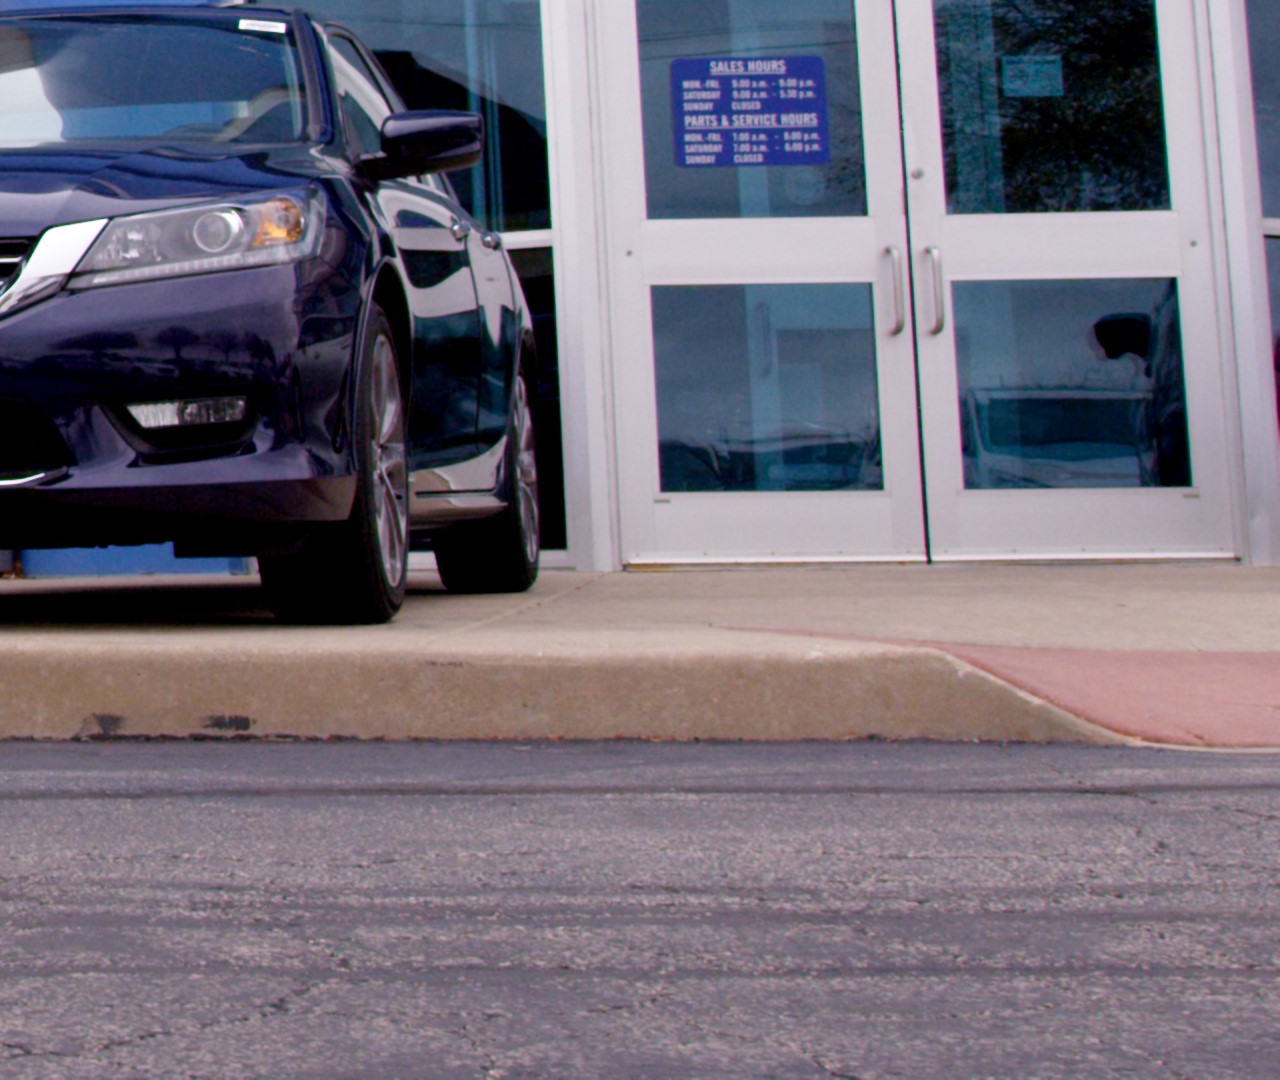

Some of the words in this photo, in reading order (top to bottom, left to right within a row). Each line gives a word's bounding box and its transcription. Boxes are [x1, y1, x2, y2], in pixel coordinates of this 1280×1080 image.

[709, 60, 745, 73] SALES
[747, 60, 787, 72] HOURS
[683, 101, 715, 112] SUNDAY
[731, 100, 762, 111] CLOSED
[684, 114, 719, 127] PARTS
[721, 114, 730, 127] &
[731, 113, 777, 127] SERVICE
[780, 112, 818, 126] HOURS
[685, 154, 717, 165] SUNDAY
[733, 153, 764, 164] CLOSED
